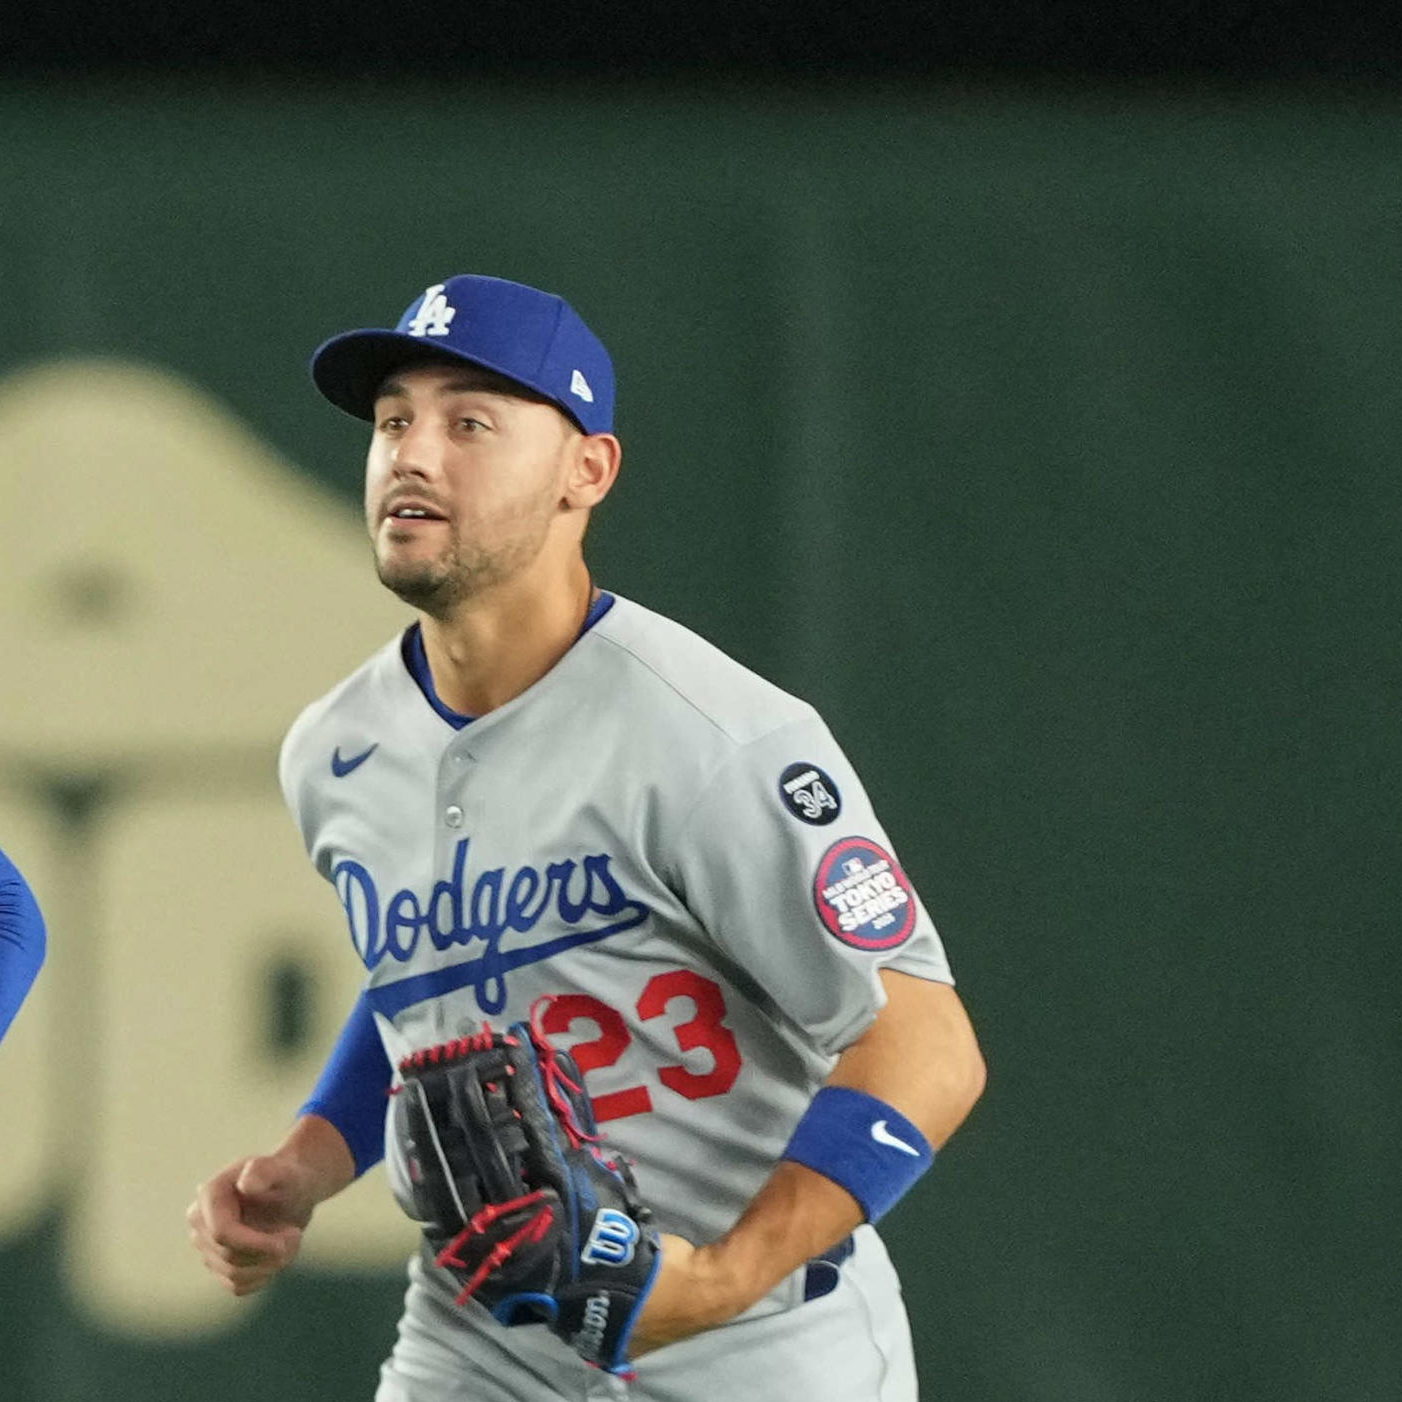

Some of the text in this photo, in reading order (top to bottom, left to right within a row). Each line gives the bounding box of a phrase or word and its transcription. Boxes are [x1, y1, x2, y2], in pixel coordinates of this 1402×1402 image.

[408, 284, 456, 337] LA
[793, 781, 837, 818] 34
[829, 871, 896, 912] TOKYO
[838, 886, 908, 932] SERIES
[333, 837, 648, 1016] Dodgers
[539, 969, 743, 1125] 23
